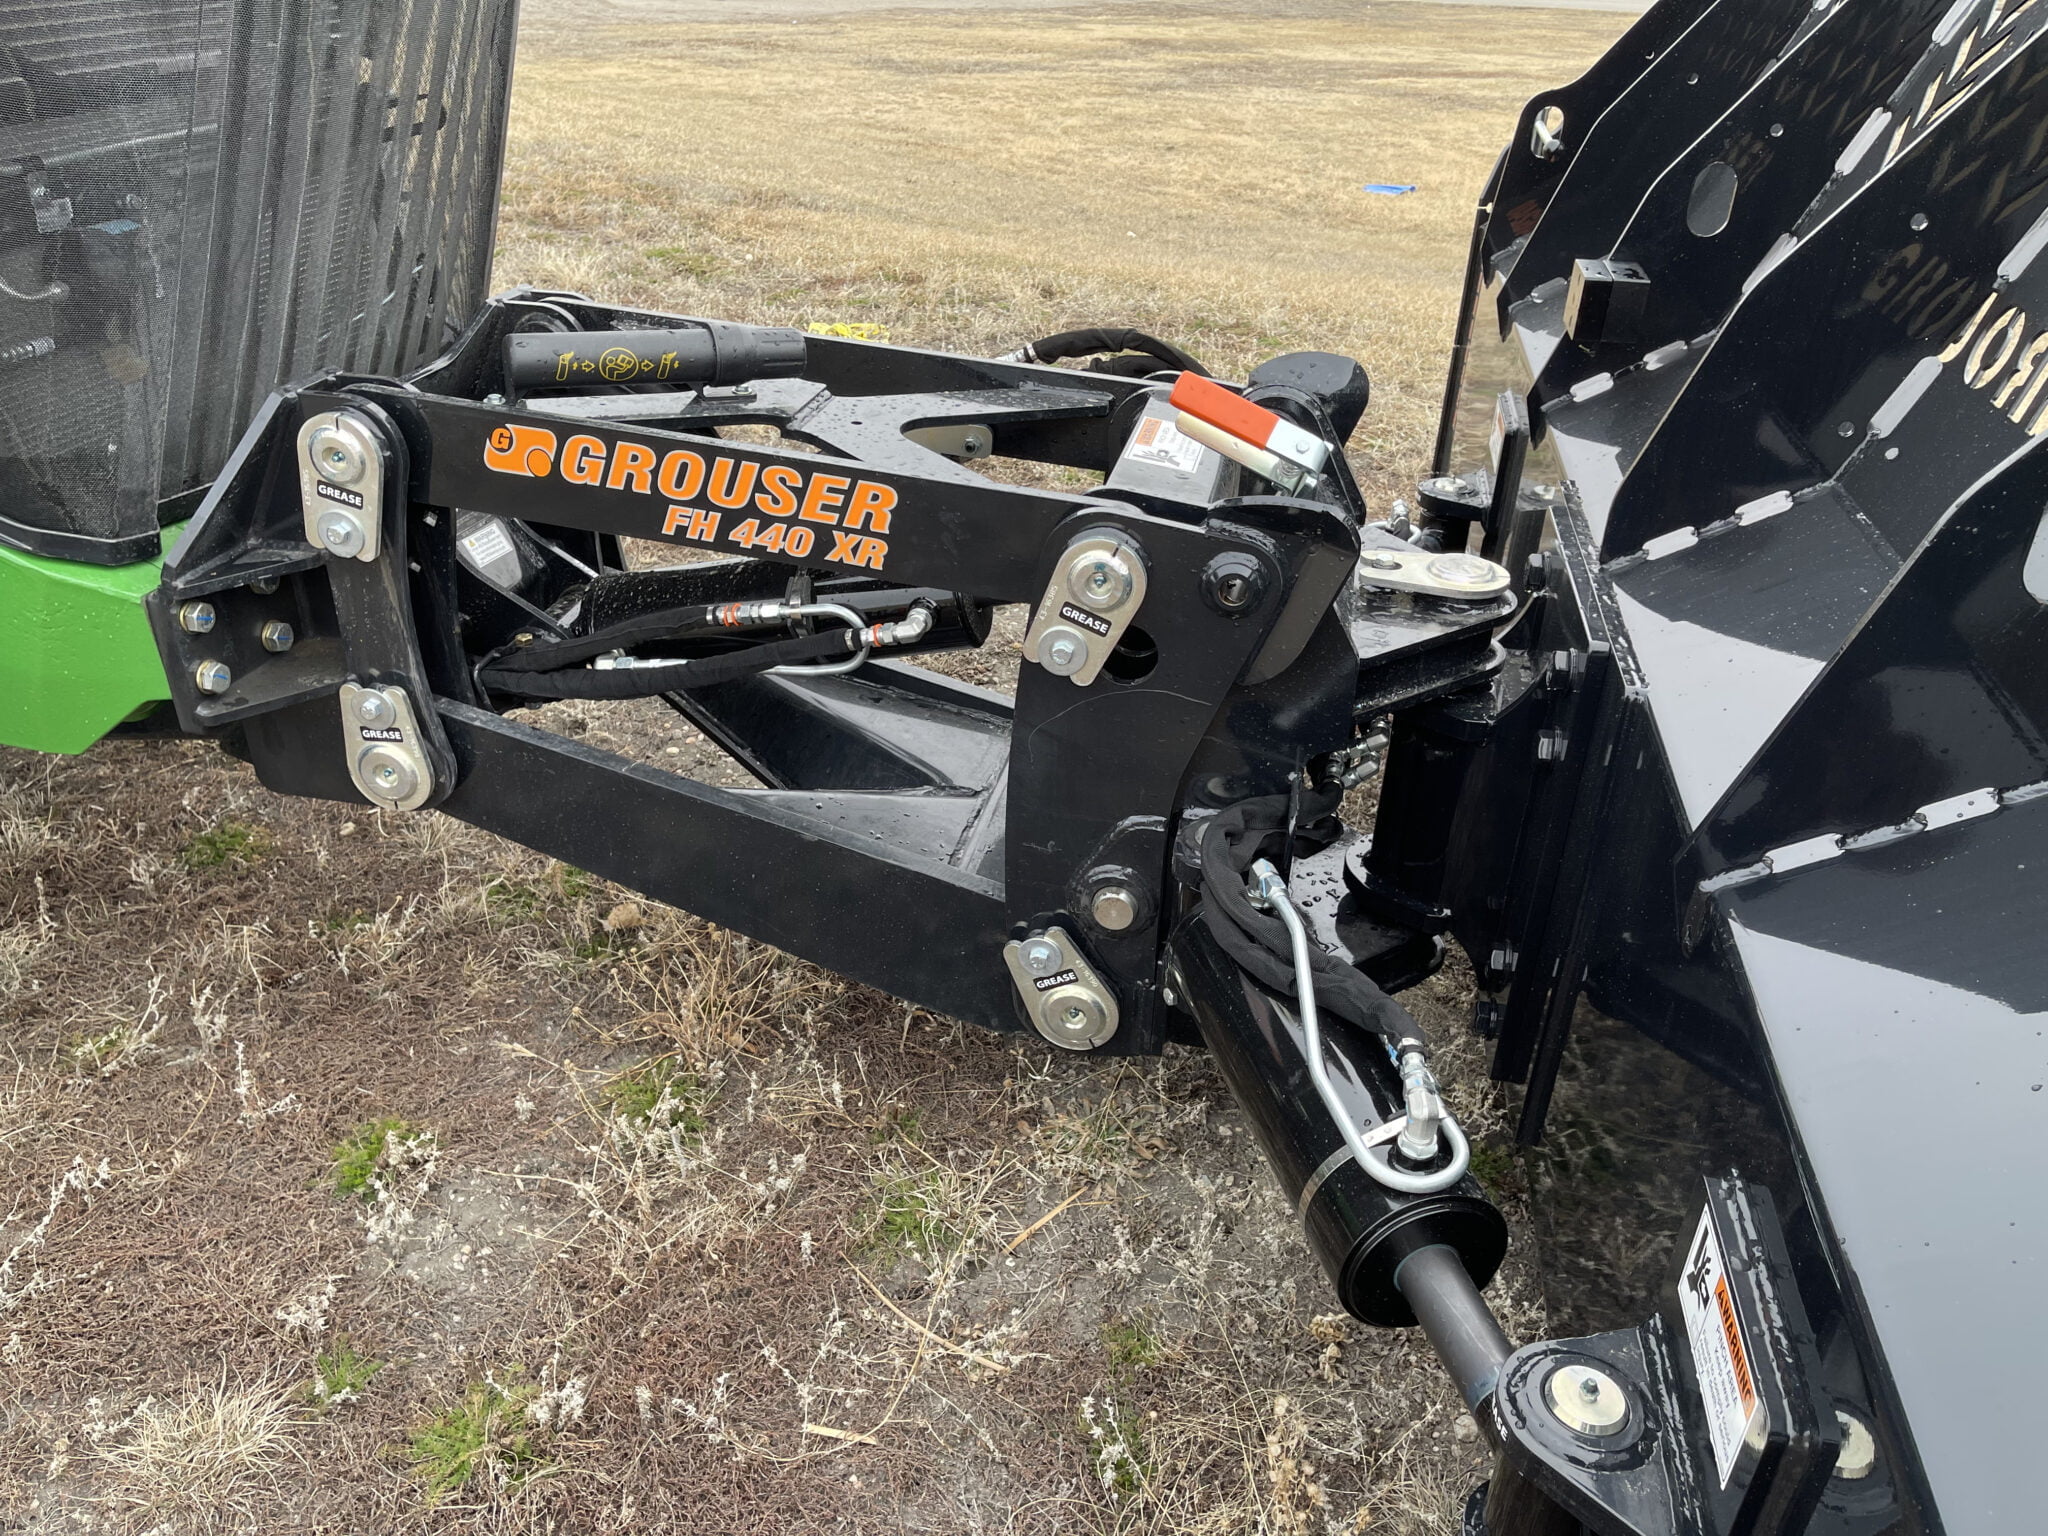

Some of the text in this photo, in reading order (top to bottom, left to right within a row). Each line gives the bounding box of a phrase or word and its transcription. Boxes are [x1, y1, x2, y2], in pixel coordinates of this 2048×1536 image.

[318, 484, 362, 507] GREASE
[560, 434, 899, 534] GROUSER
[661, 504, 889, 571] FH 440 XR
[1061, 605, 1110, 634] GREASE
[362, 729, 402, 740] GREASE
[1036, 972, 1077, 990] GREASE
[1716, 1323, 1738, 1406] PINCH AREA
[1720, 1299, 1752, 1404] WARNING
